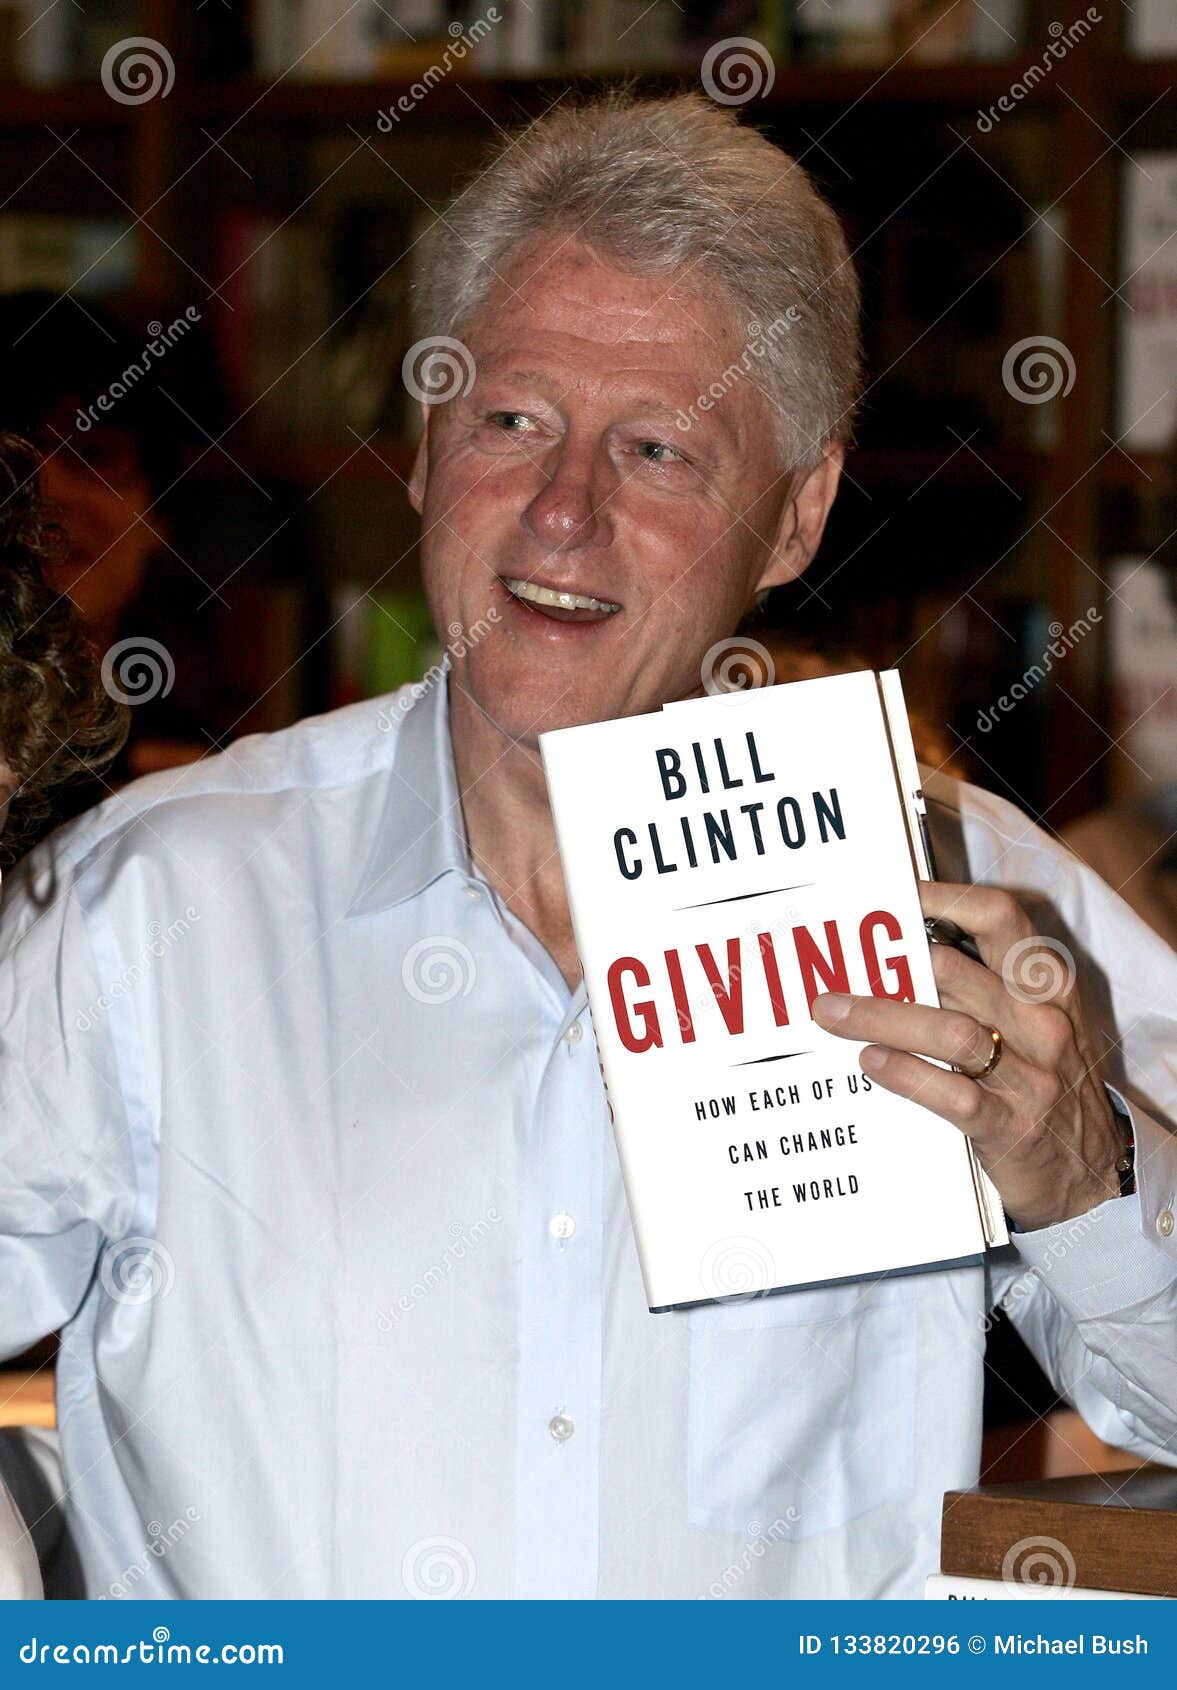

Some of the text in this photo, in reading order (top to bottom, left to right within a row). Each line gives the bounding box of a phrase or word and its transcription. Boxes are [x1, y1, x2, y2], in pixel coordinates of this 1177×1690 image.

[655, 731, 775, 801] BILL
[613, 787, 847, 881] CLINTON
[607, 911, 915, 1053] GIVING
[694, 1072, 872, 1121] HOW EACH OF US
[728, 1124, 858, 1165] CAN CHANGE
[743, 1174, 859, 1211] THE WORLD
